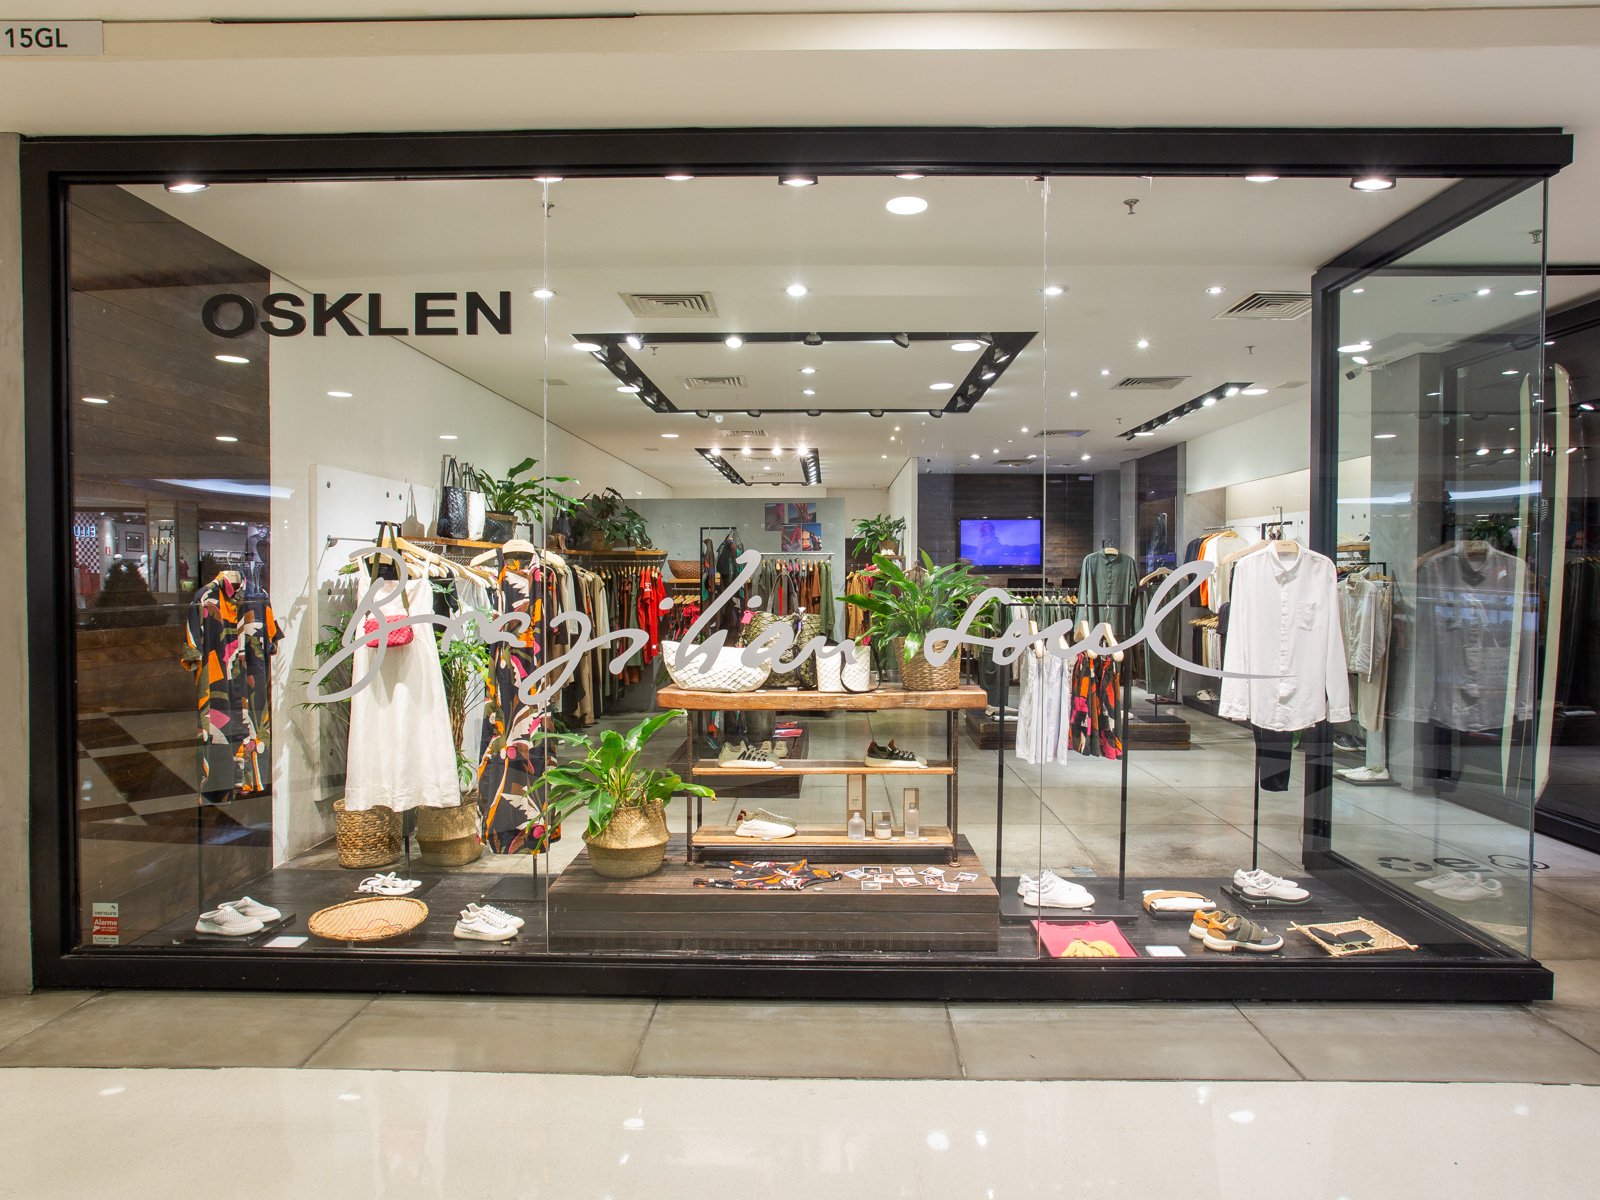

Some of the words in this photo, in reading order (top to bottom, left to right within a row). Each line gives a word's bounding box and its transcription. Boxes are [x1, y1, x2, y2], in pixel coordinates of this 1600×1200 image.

[5, 27, 68, 48] 15GL
[201, 290, 512, 338] OSKLEN
[307, 547, 857, 704] Brazilian
[94, 918, 118, 926] Alarme
